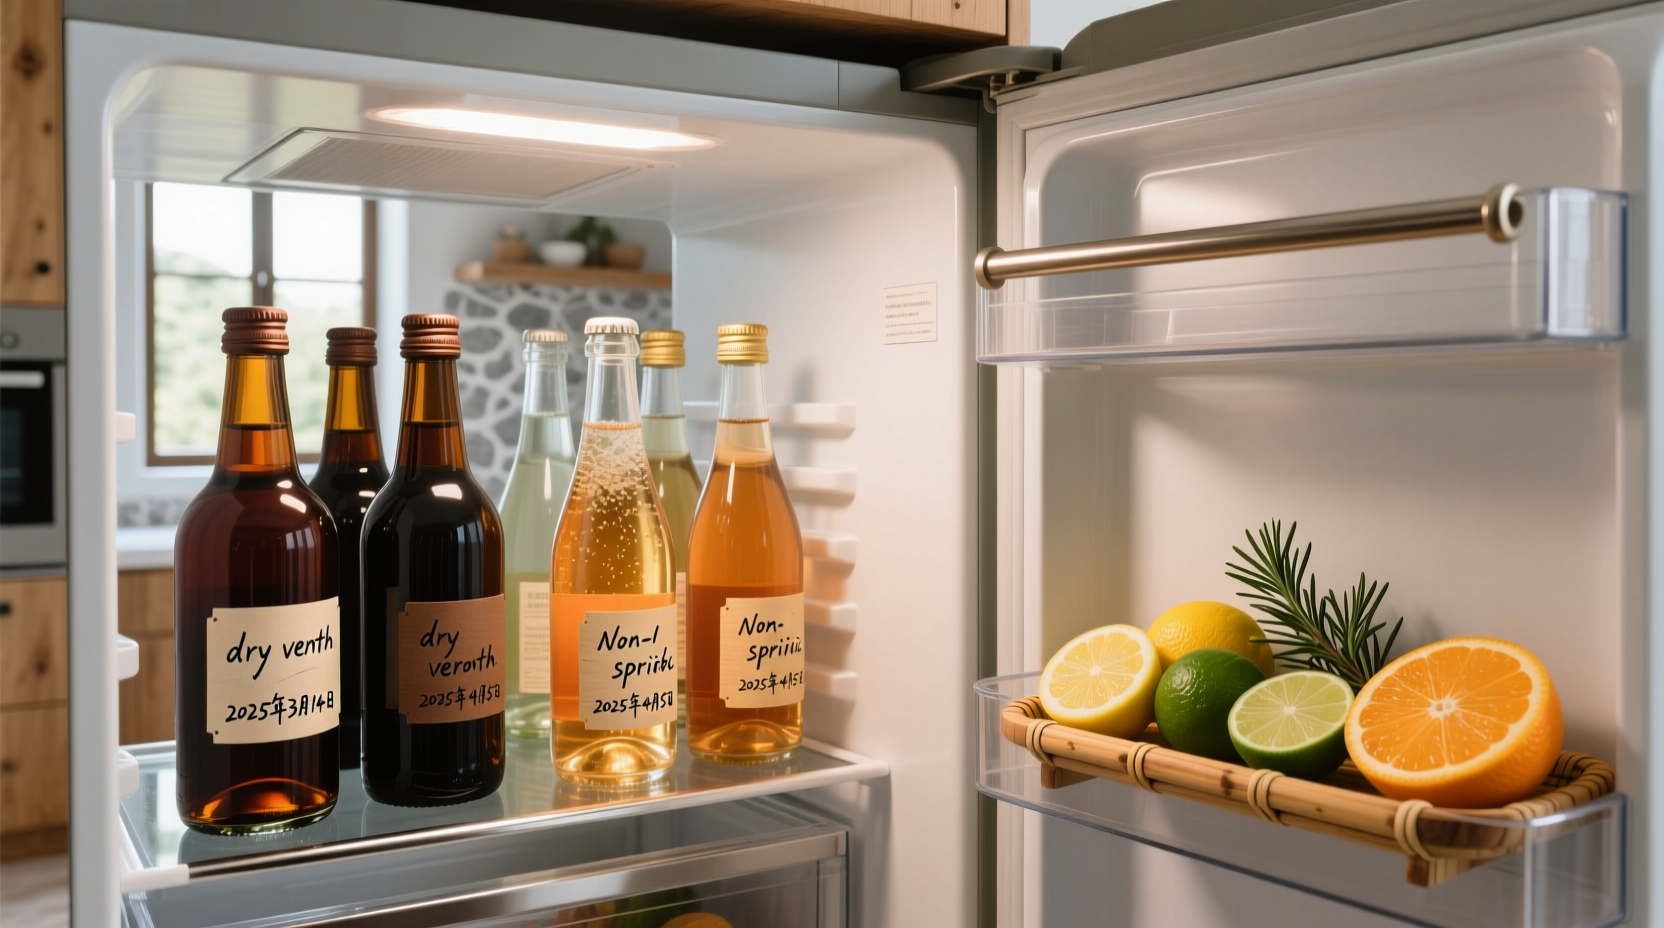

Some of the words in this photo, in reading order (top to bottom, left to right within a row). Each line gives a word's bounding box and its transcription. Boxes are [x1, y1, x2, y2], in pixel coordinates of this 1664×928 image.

[420, 619, 460, 658] dry
[738, 613, 784, 636] Non-
[226, 631, 272, 680] dry
[225, 690, 334, 725] 2025年3月14日
